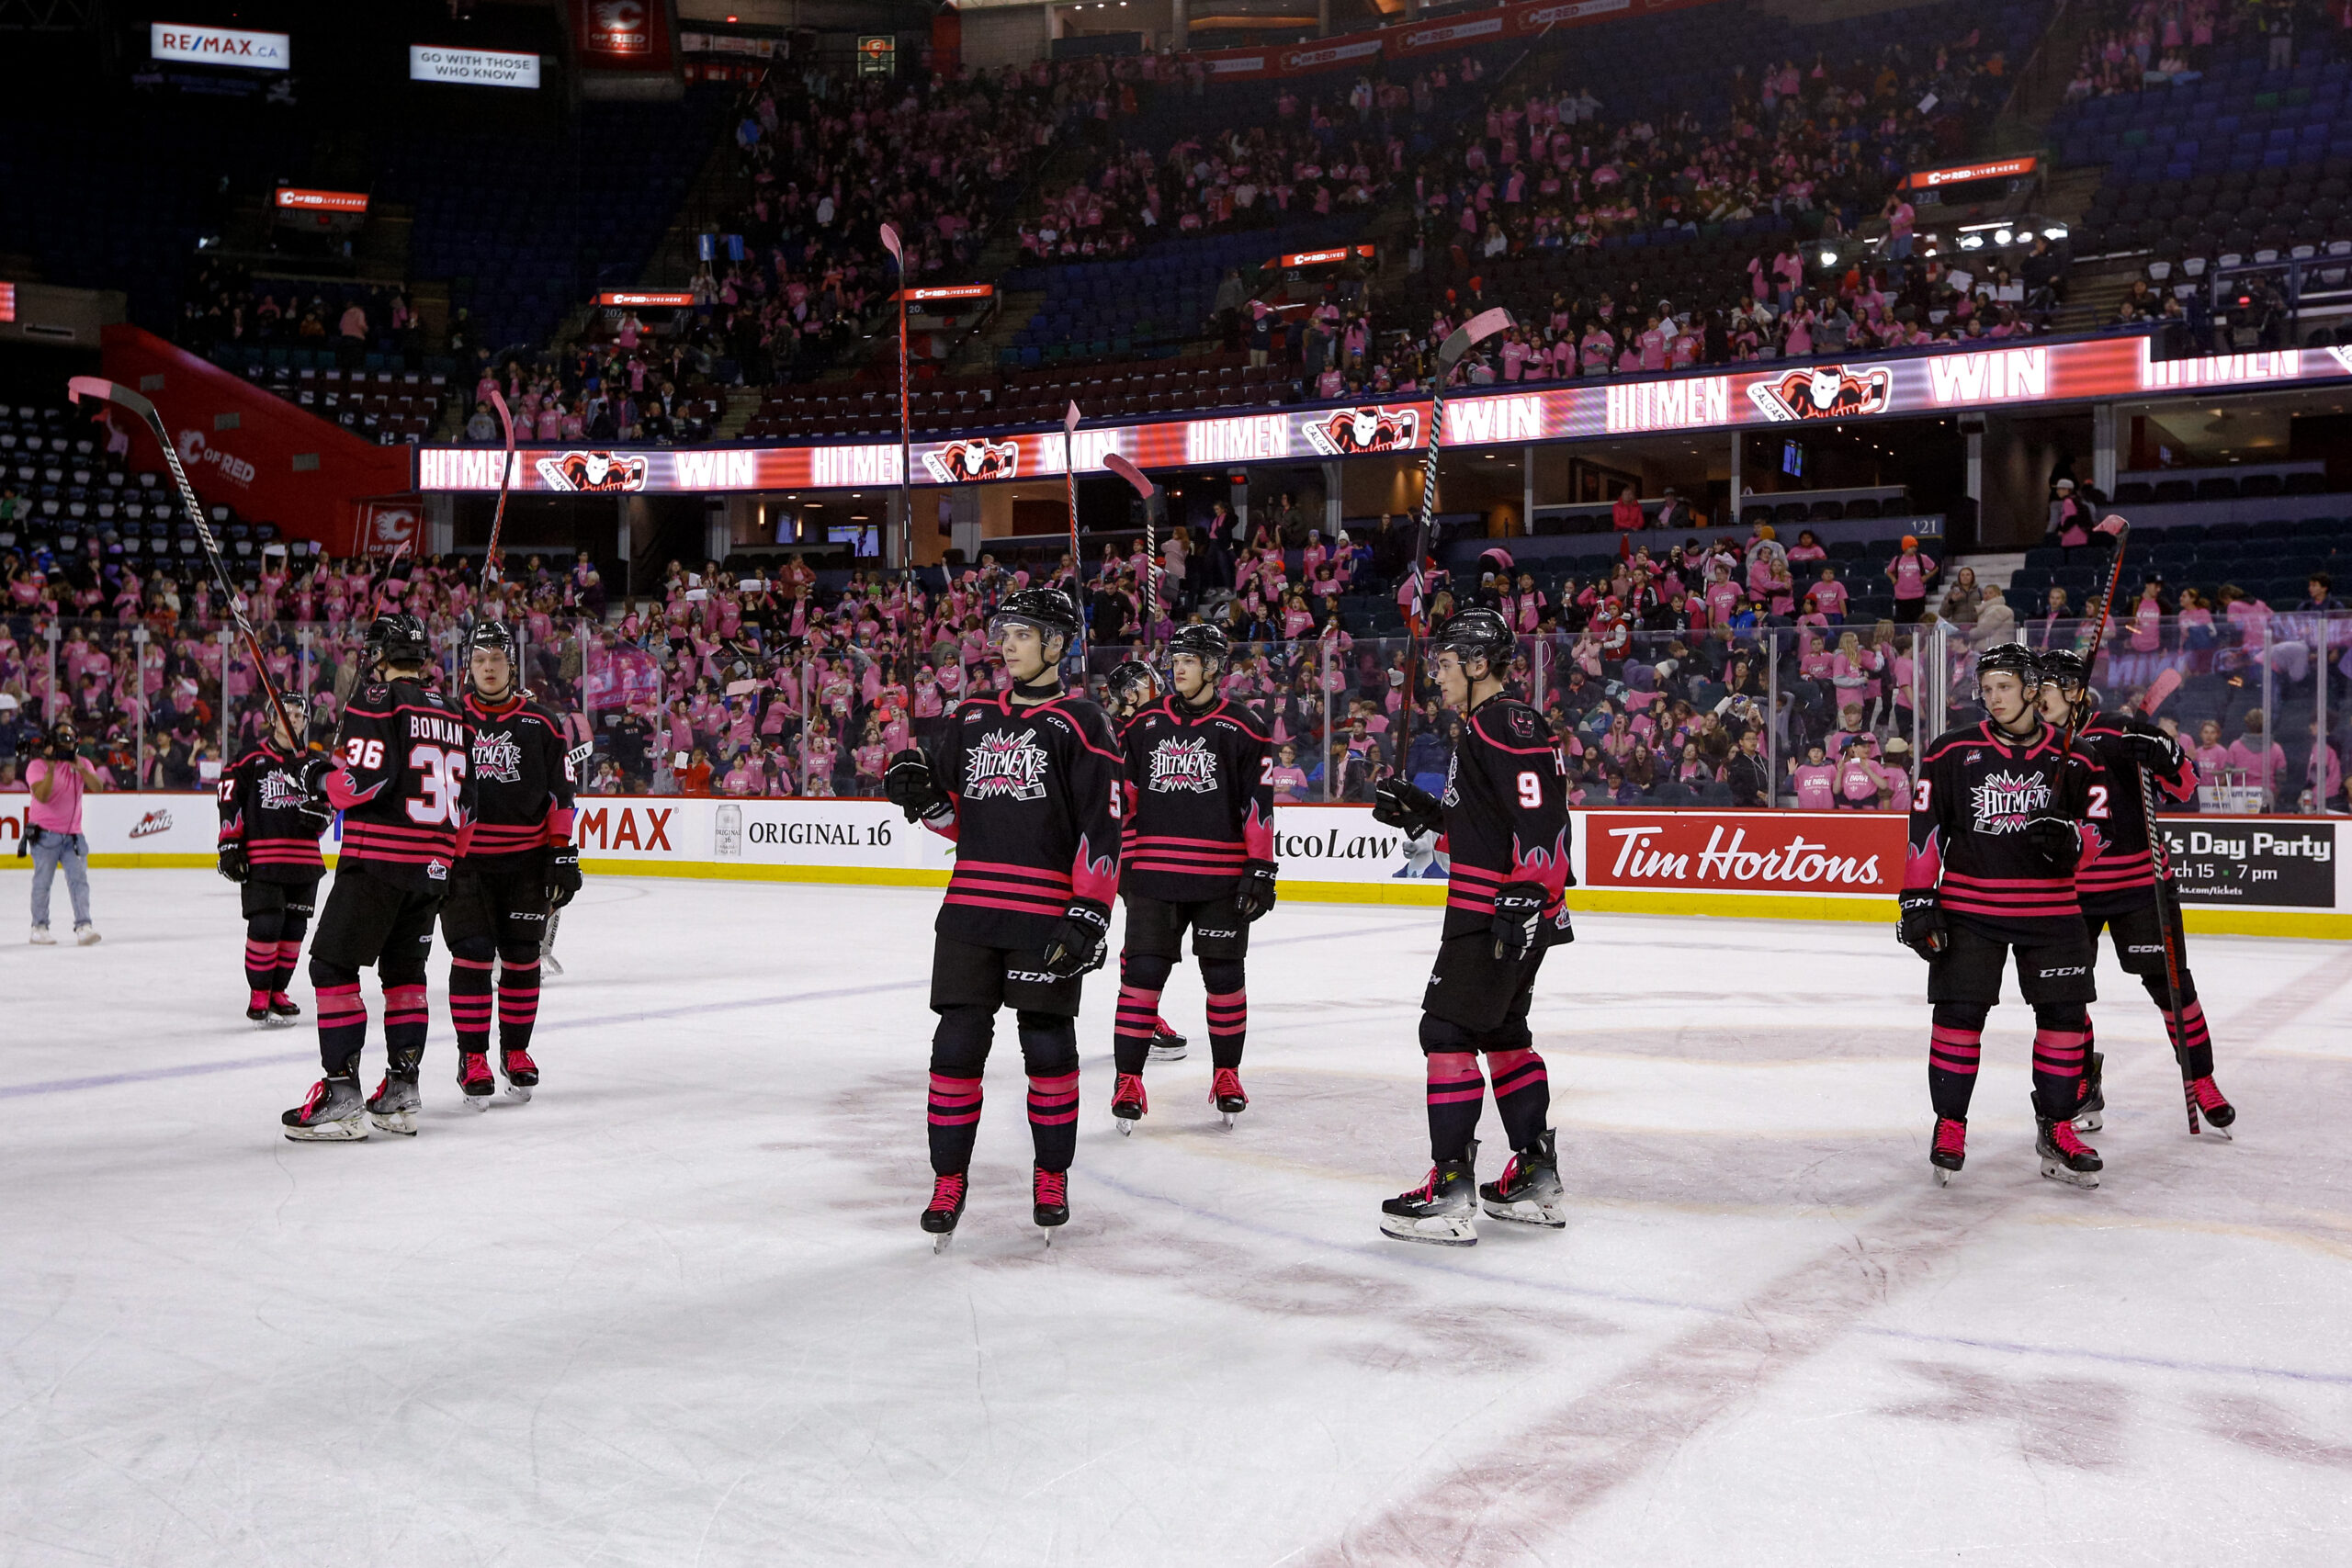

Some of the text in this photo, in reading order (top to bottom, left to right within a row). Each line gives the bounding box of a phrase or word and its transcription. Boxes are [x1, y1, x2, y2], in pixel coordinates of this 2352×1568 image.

[610, 33, 646, 43] RED
[421, 52, 530, 70] GO WITH THOSE
[435, 65, 516, 80] WHO KNOW
[1951, 170, 1972, 179] RED
[1997, 164, 2019, 172] HERE
[304, 196, 322, 204] RED
[1928, 348, 2047, 403] WIN
[1608, 376, 1727, 431] HITMEN
[1750, 387, 1786, 422] CALGAR
[1448, 396, 1541, 443] WIN
[1041, 430, 1119, 472] WIN
[1189, 413, 1287, 461] HITMEN
[1306, 424, 1333, 456] CALGAR
[203, 447, 221, 464] OF
[220, 454, 255, 483] RED
[420, 450, 521, 490] HITMEN
[540, 462, 567, 491] CALGAR
[676, 450, 754, 489] WIN
[814, 444, 903, 485] HITMEN
[924, 456, 948, 483] CALGAR
[409, 715, 464, 747] BOWLAN
[1046, 716, 1070, 734] CCM
[1215, 720, 1238, 732] CCM
[345, 738, 386, 772] 36
[973, 747, 1043, 780] HITMEN
[1155, 751, 1212, 779] HITMEN
[404, 742, 469, 829] 36
[1517, 771, 1543, 809] 9
[1983, 788, 2051, 819] HITMEN
[2086, 784, 2109, 819] 2
[749, 819, 892, 846] ORIGINAL 16
[1272, 829, 1398, 860] tcoLaw
[2189, 830, 2246, 860] Day
[2253, 831, 2332, 863] Party
[1609, 824, 1879, 885] Tim Hortons
[2171, 860, 2278, 883] rch 15 7 pm
[1494, 897, 1542, 908] CCM
[1899, 897, 1934, 909] CCM
[2177, 883, 2243, 896] ks.com/tickets
[508, 911, 546, 921] CCM
[1068, 907, 1109, 929] CCM
[1197, 928, 1238, 939] CCM
[1006, 969, 1057, 985] CCM
[2039, 965, 2086, 978] CCM
